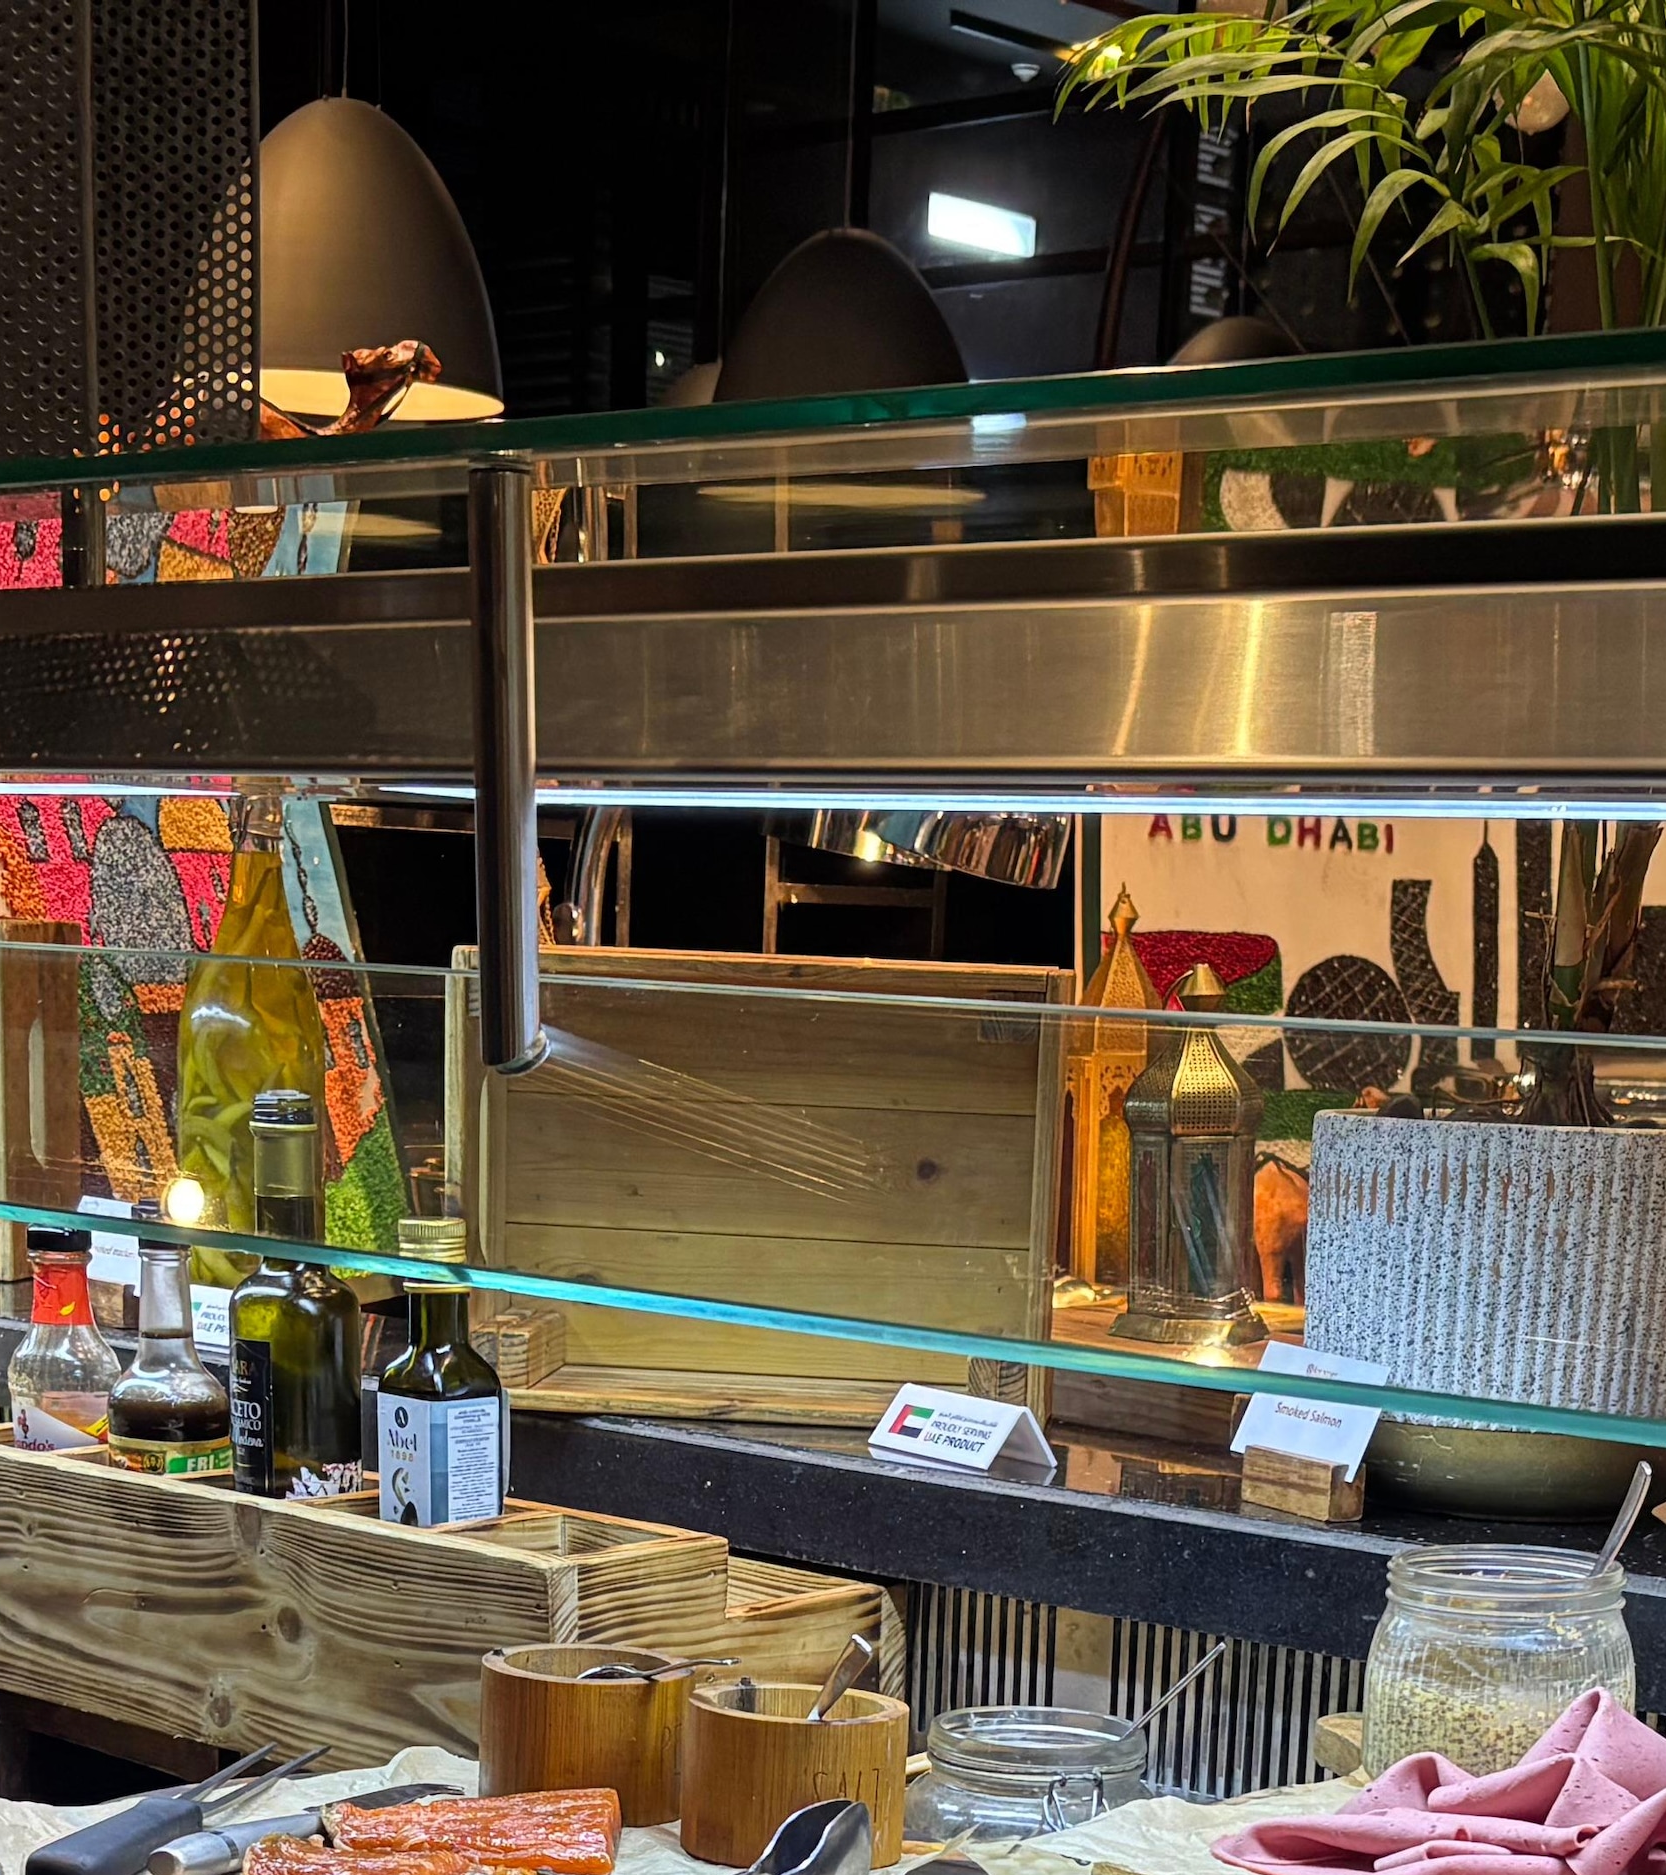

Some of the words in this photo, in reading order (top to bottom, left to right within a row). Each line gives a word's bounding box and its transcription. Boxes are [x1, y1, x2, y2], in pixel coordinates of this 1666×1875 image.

[1147, 814, 1237, 843] ABU
[1266, 814, 1394, 854] DHABI
[232, 1399, 262, 1419] CETO
[1275, 1401, 1310, 1421] Smoked
[1308, 1410, 1342, 1429] Salmon
[15, 1438, 56, 1452] ando's
[387, 1428, 417, 1452] Abel
[942, 1435, 986, 1453] PRODUCT
